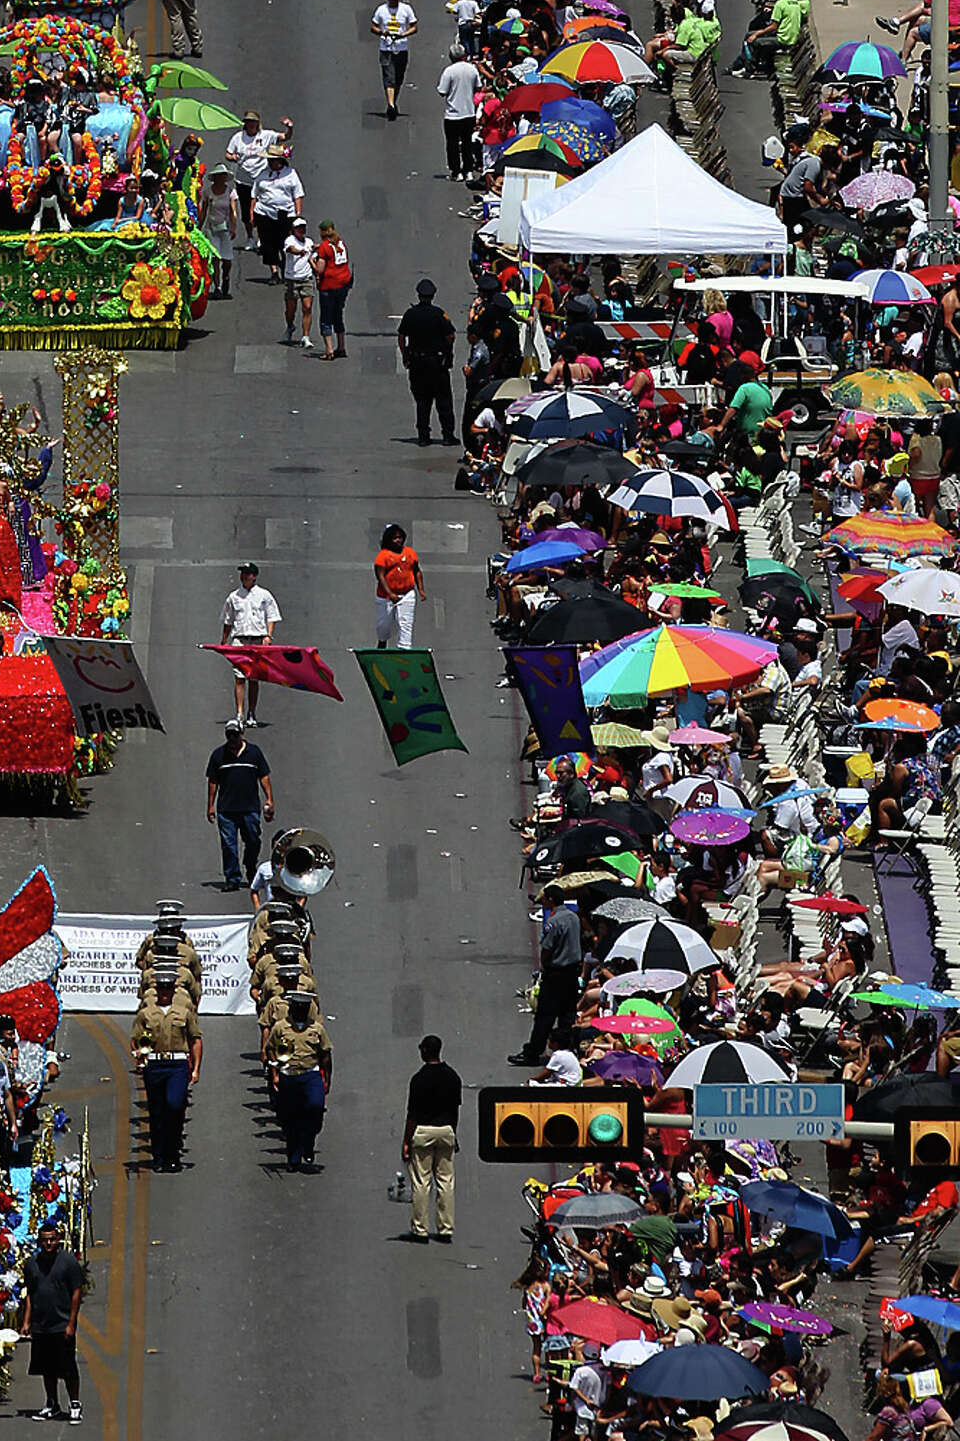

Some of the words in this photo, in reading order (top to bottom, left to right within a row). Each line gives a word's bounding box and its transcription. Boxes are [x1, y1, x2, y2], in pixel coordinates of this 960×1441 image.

[80, 703, 166, 735] Fiesta
[70, 961, 111, 969] DUCHESS
[92, 976, 141, 985] ELIZAB
[60, 984, 101, 994] DUCHESS
[104, 985, 117, 993] OF
[721, 1087, 817, 1115] THIRD
[714, 1121, 737, 1135] 100
[796, 1121, 825, 1136] 200
